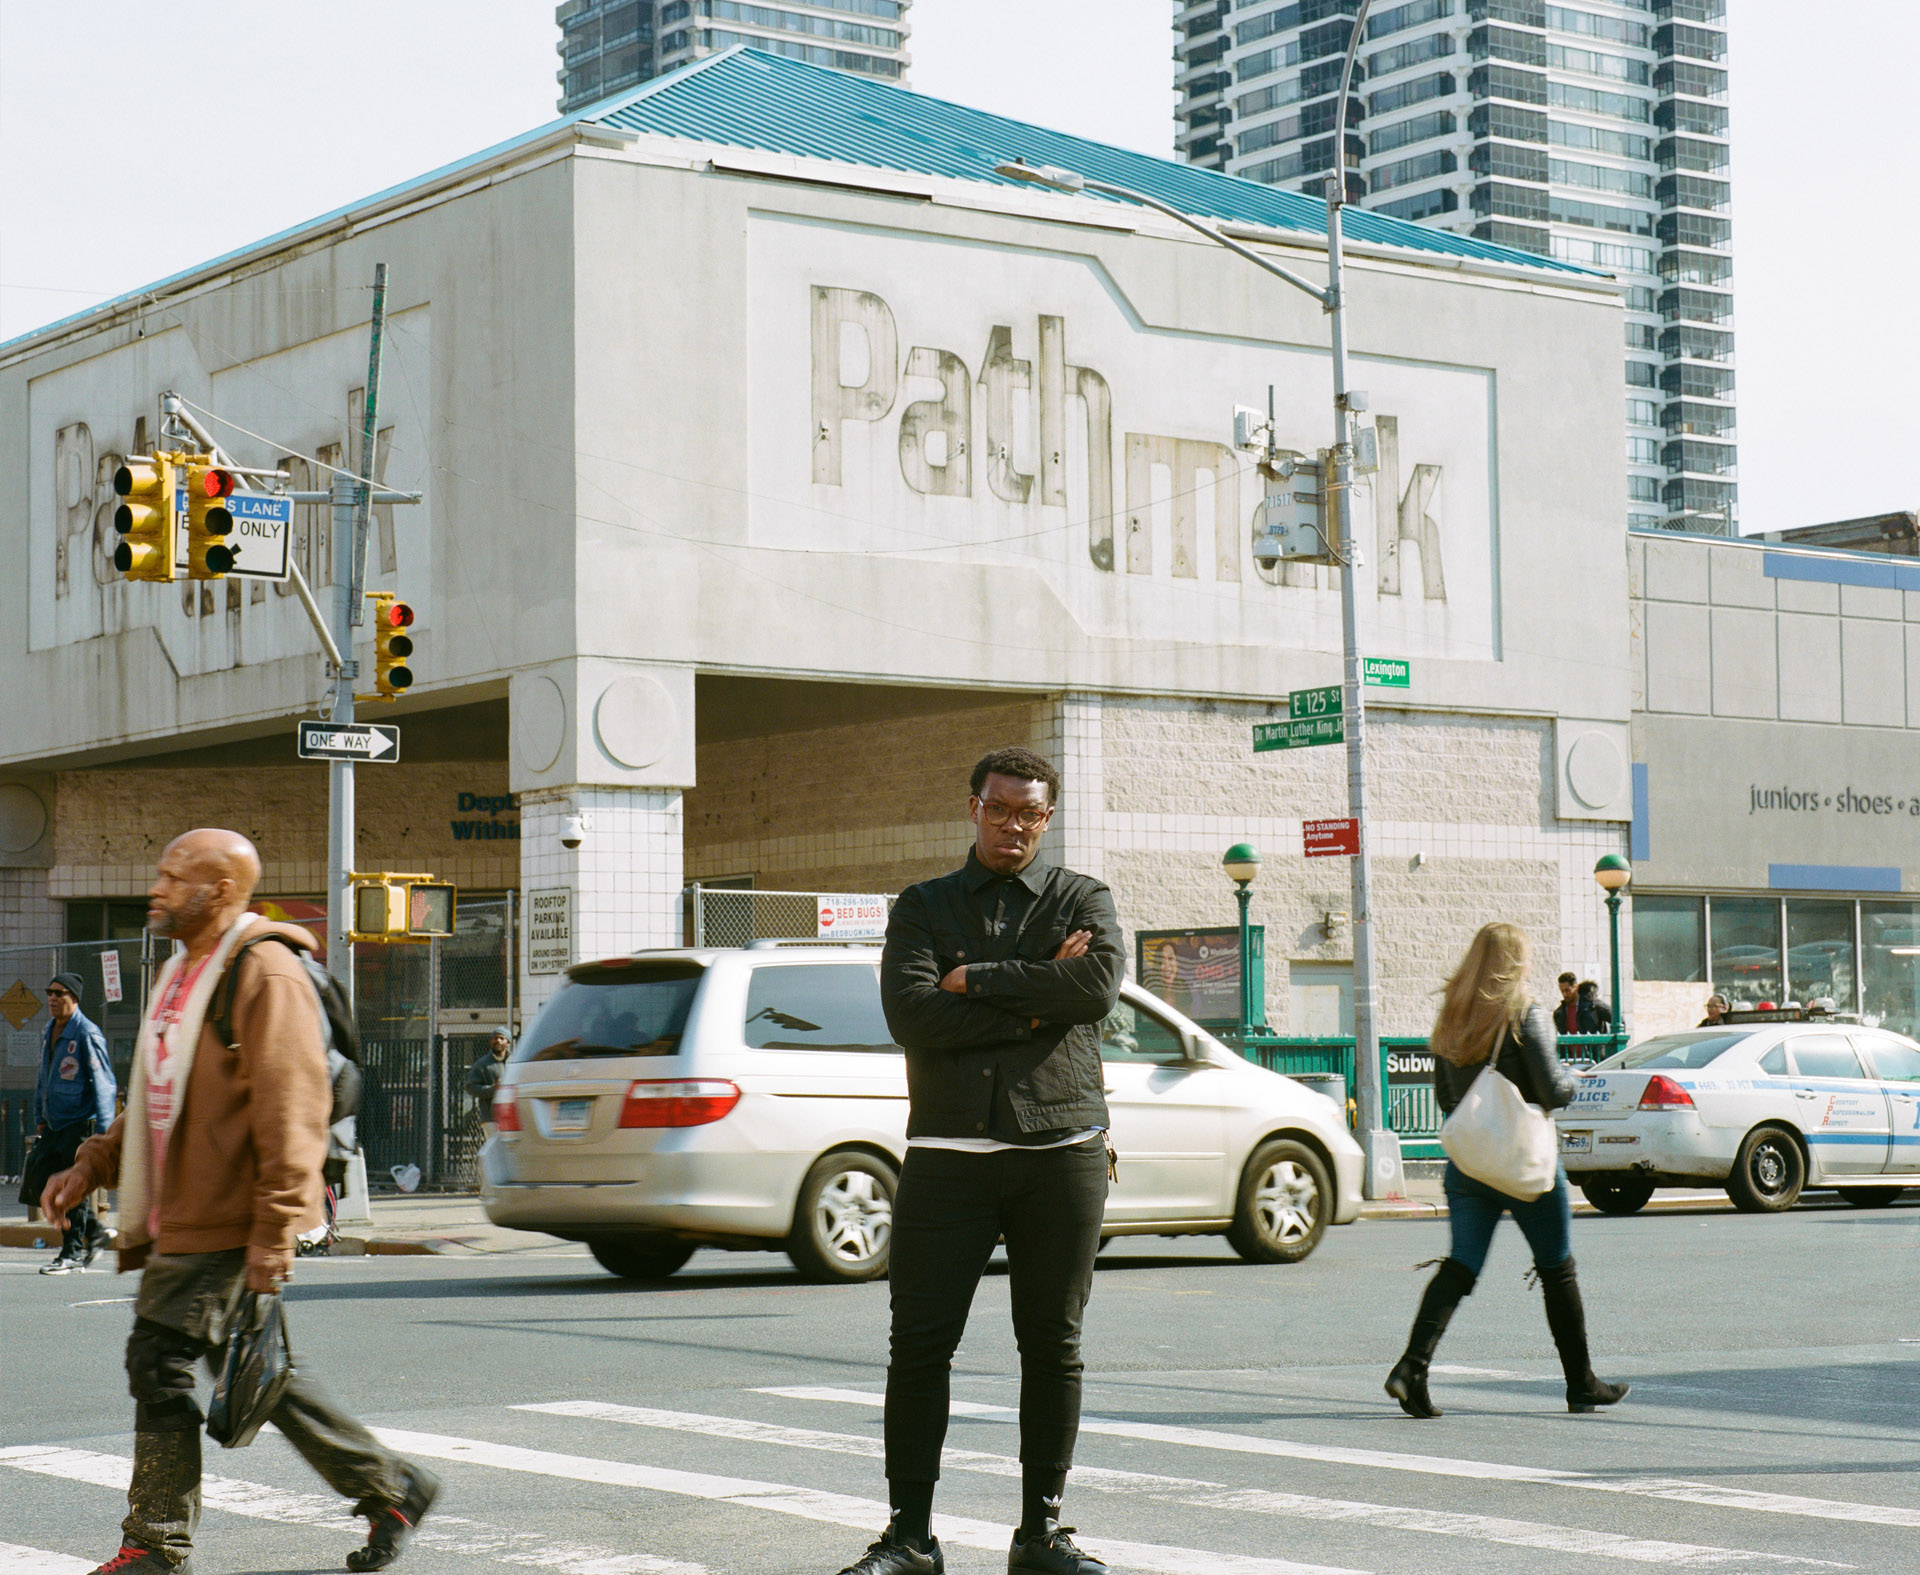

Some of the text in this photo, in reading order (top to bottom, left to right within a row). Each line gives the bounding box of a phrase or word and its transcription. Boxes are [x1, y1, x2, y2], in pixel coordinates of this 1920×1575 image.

[810, 284, 1448, 602] Pathmk
[241, 501, 282, 517] LANE
[240, 521, 281, 538] ONLY
[1365, 660, 1406, 680] Lexington
[1294, 690, 1340, 715] E 125 St
[1255, 728, 1263, 741] Dr
[1265, 725, 1288, 740] Martin
[1290, 722, 1314, 737] Luther
[1317, 720, 1332, 737] King
[310, 733, 371, 749] ONE WAY
[1749, 784, 1819, 815] juniors
[1837, 786, 1893, 814] shoes
[1305, 821, 1350, 831] NO STANDING
[1306, 831, 1334, 841] Anytime
[534, 896, 566, 909] ROOFTOP
[534, 912, 565, 924] PARKING
[837, 908, 854, 919] BED
[531, 927, 568, 940] AVAILABLE
[1387, 1053, 1435, 1073] Subw
[1572, 1092, 1610, 1102] OLICE
